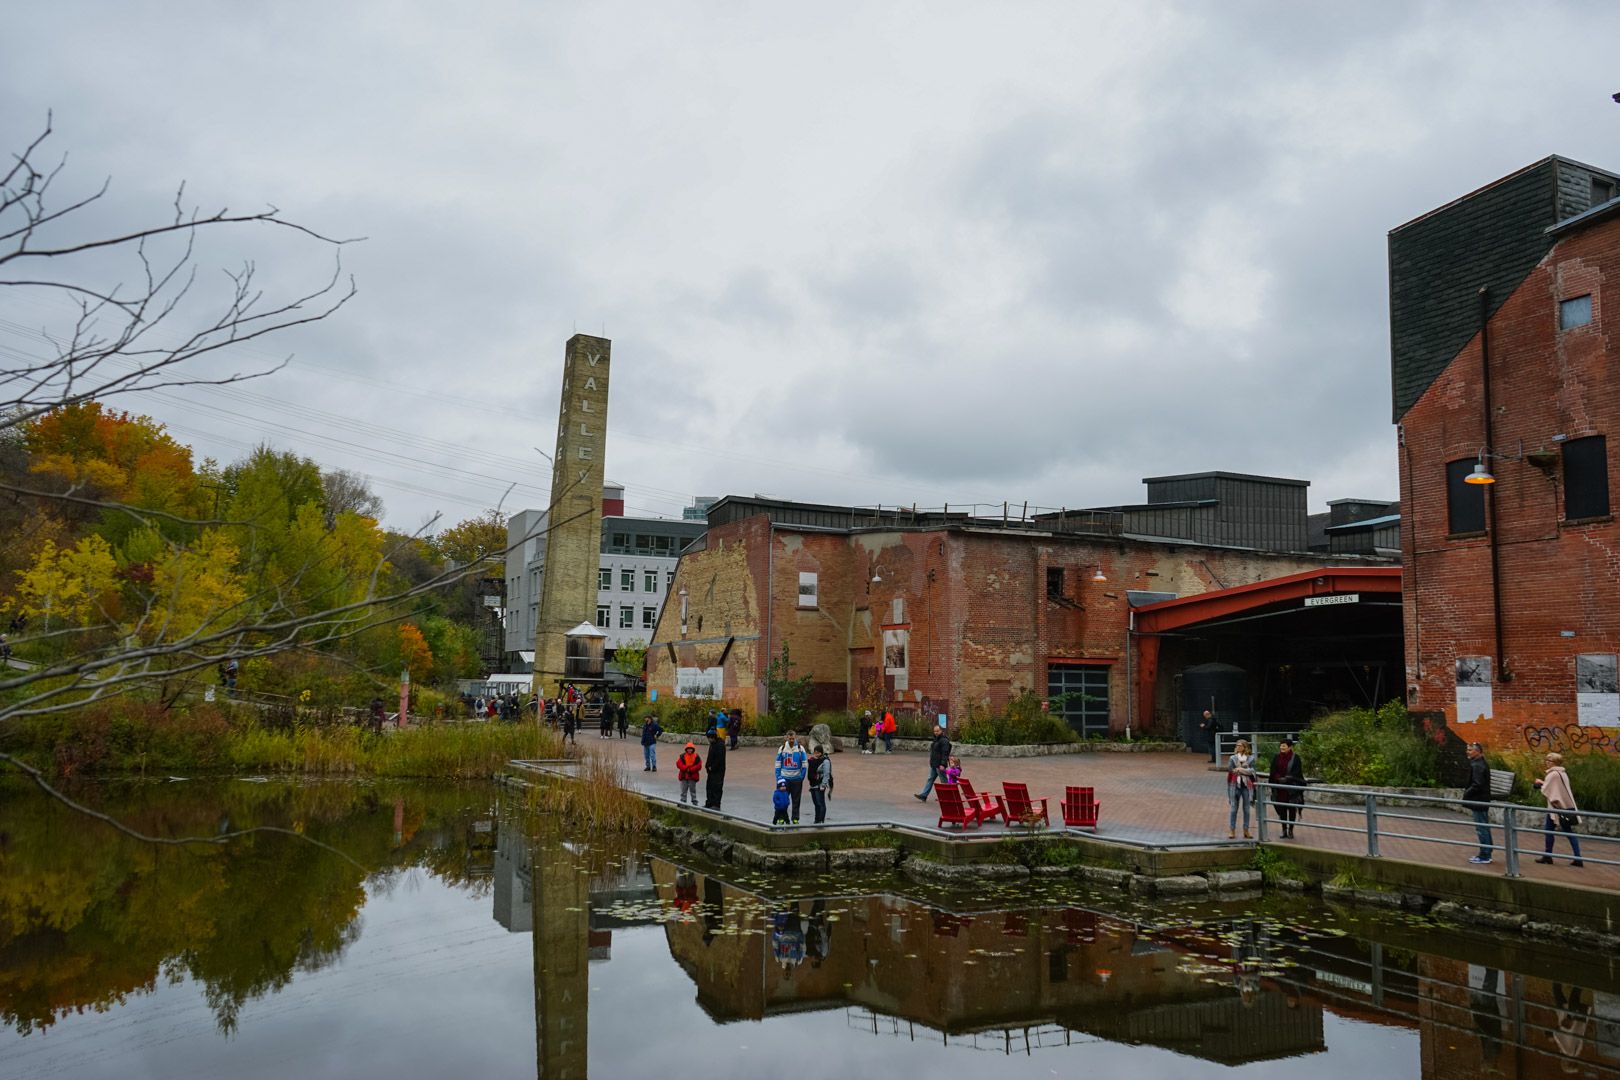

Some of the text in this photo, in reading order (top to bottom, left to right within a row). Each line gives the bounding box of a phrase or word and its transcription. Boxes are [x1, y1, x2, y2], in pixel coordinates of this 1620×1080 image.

[555, 353, 572, 484] VALLEY
[578, 352, 600, 484] VALLEY
[1310, 595, 1353, 605] EVERGREEN
